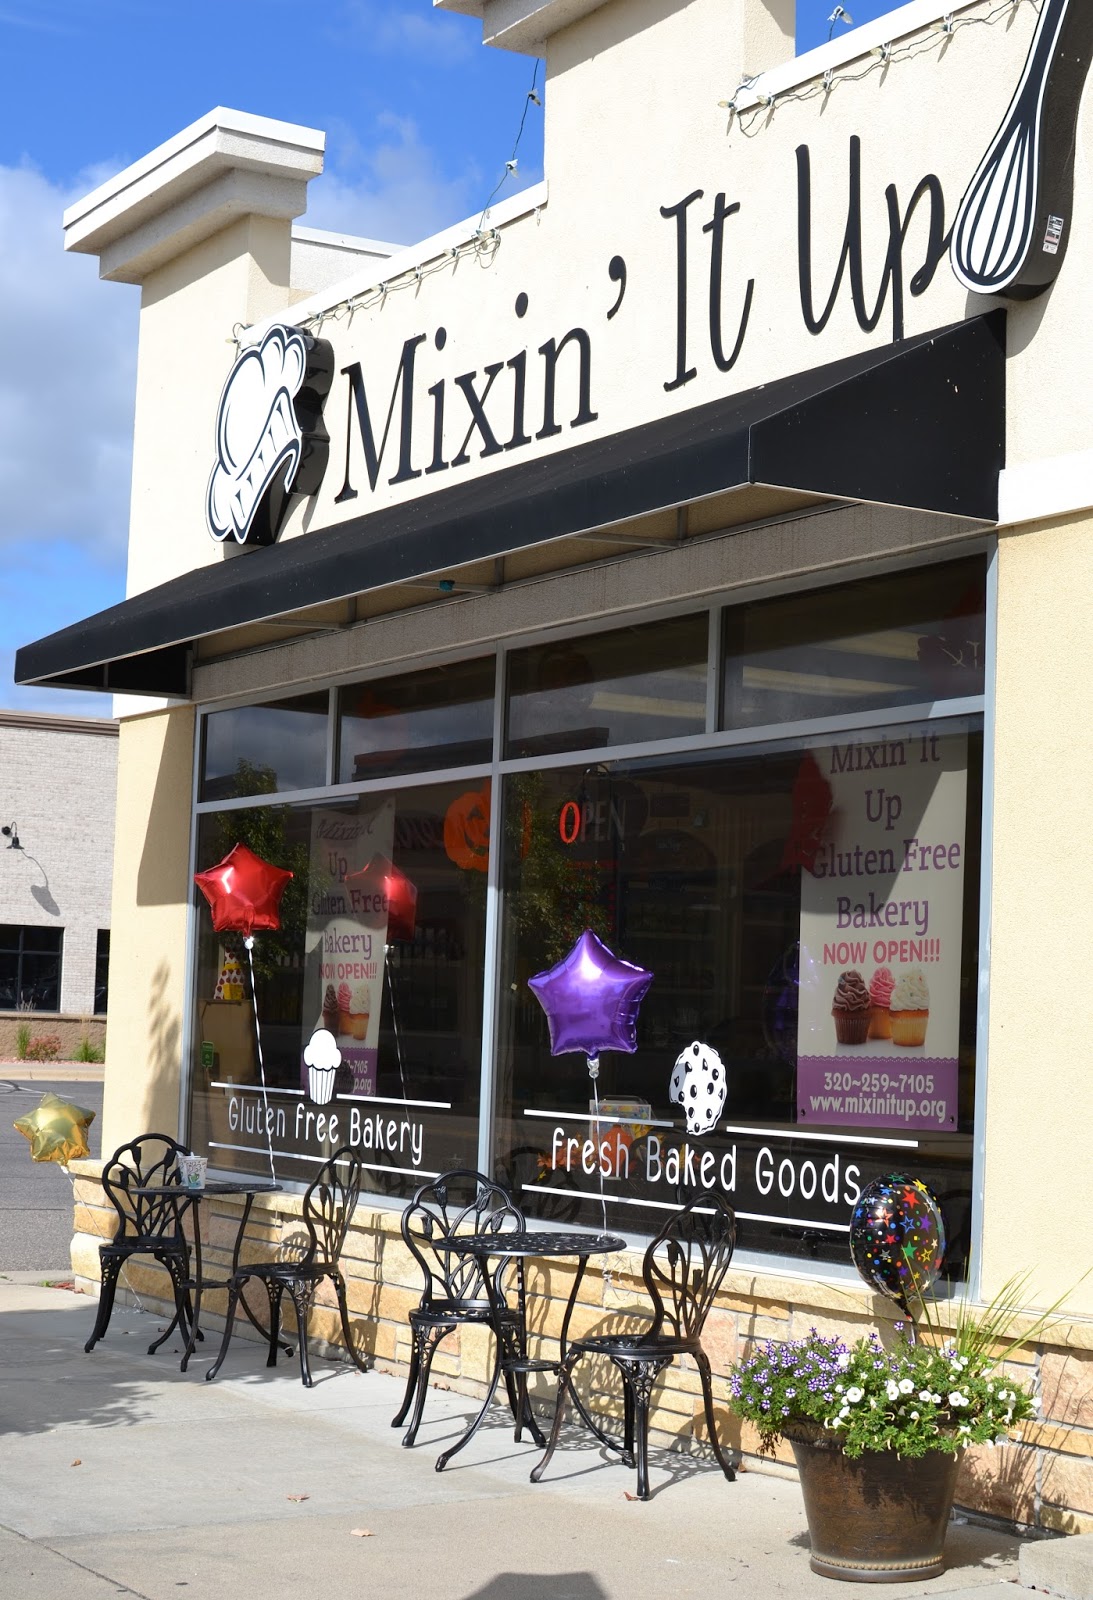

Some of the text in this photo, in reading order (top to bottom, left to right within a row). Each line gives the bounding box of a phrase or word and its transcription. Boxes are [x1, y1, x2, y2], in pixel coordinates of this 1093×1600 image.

[335, 134, 952, 504] Mixin' It Up
[830, 729, 940, 774] Mixin' It
[559, 800, 626, 844] OPEN
[865, 789, 902, 831] Up
[328, 851, 347, 883] Up
[811, 840, 961, 879] Gluten Free
[350, 888, 387, 914] Free
[836, 893, 929, 936] Bakery
[324, 926, 372, 960] Bakery
[823, 938, 940, 965] NOW OPEN!!!
[337, 962, 377, 980] OPEN!!!
[810, 1093, 946, 1124] www.mixinitup.org
[228, 1096, 286, 1138] Gluten
[350, 1107, 424, 1165] Bakery
[646, 1135, 737, 1192] Baked
[755, 1147, 861, 1206] Goods
